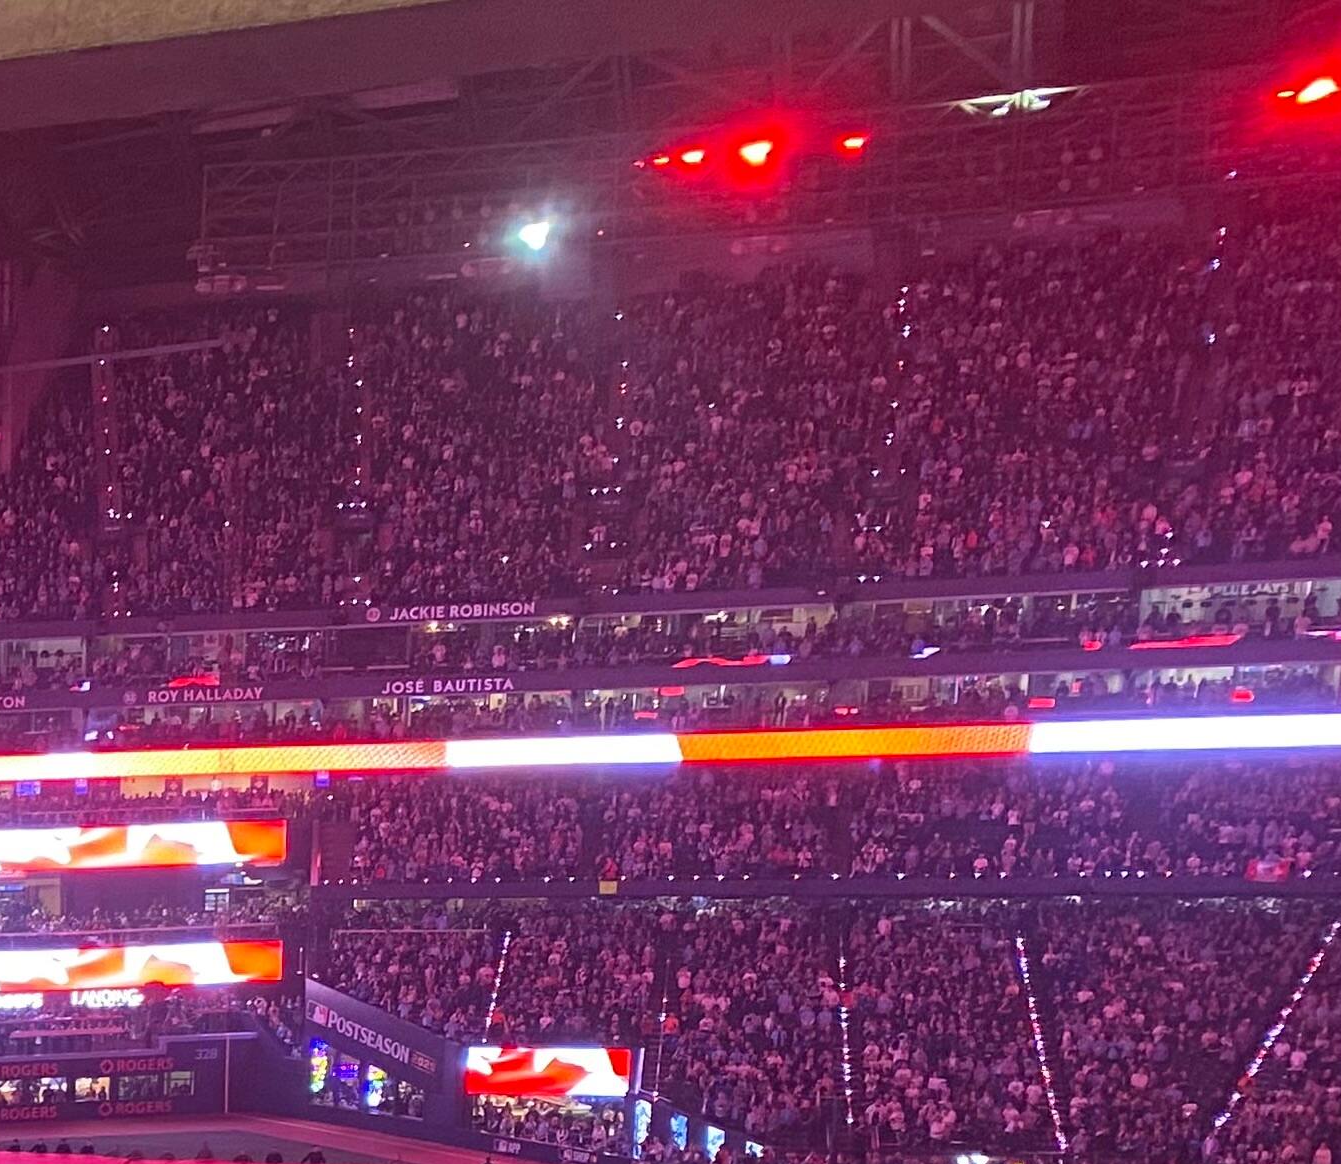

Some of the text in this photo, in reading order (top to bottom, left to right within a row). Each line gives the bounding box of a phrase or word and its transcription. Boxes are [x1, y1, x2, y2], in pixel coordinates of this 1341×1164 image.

[389, 605, 446, 621] JACKIE
[449, 602, 535, 618] ROBINSON
[147, 689, 179, 703] ROY
[183, 686, 264, 702] HALLADAY
[381, 677, 515, 696] JOSÉ BAUTISTA
[327, 1009, 410, 1063] POSTSEASON
[1, 1061, 59, 1078] ROGERS
[115, 1056, 174, 1074] ROGERS
[0, 1105, 58, 1122] ROGERS
[115, 1100, 173, 1115] ROGERS
